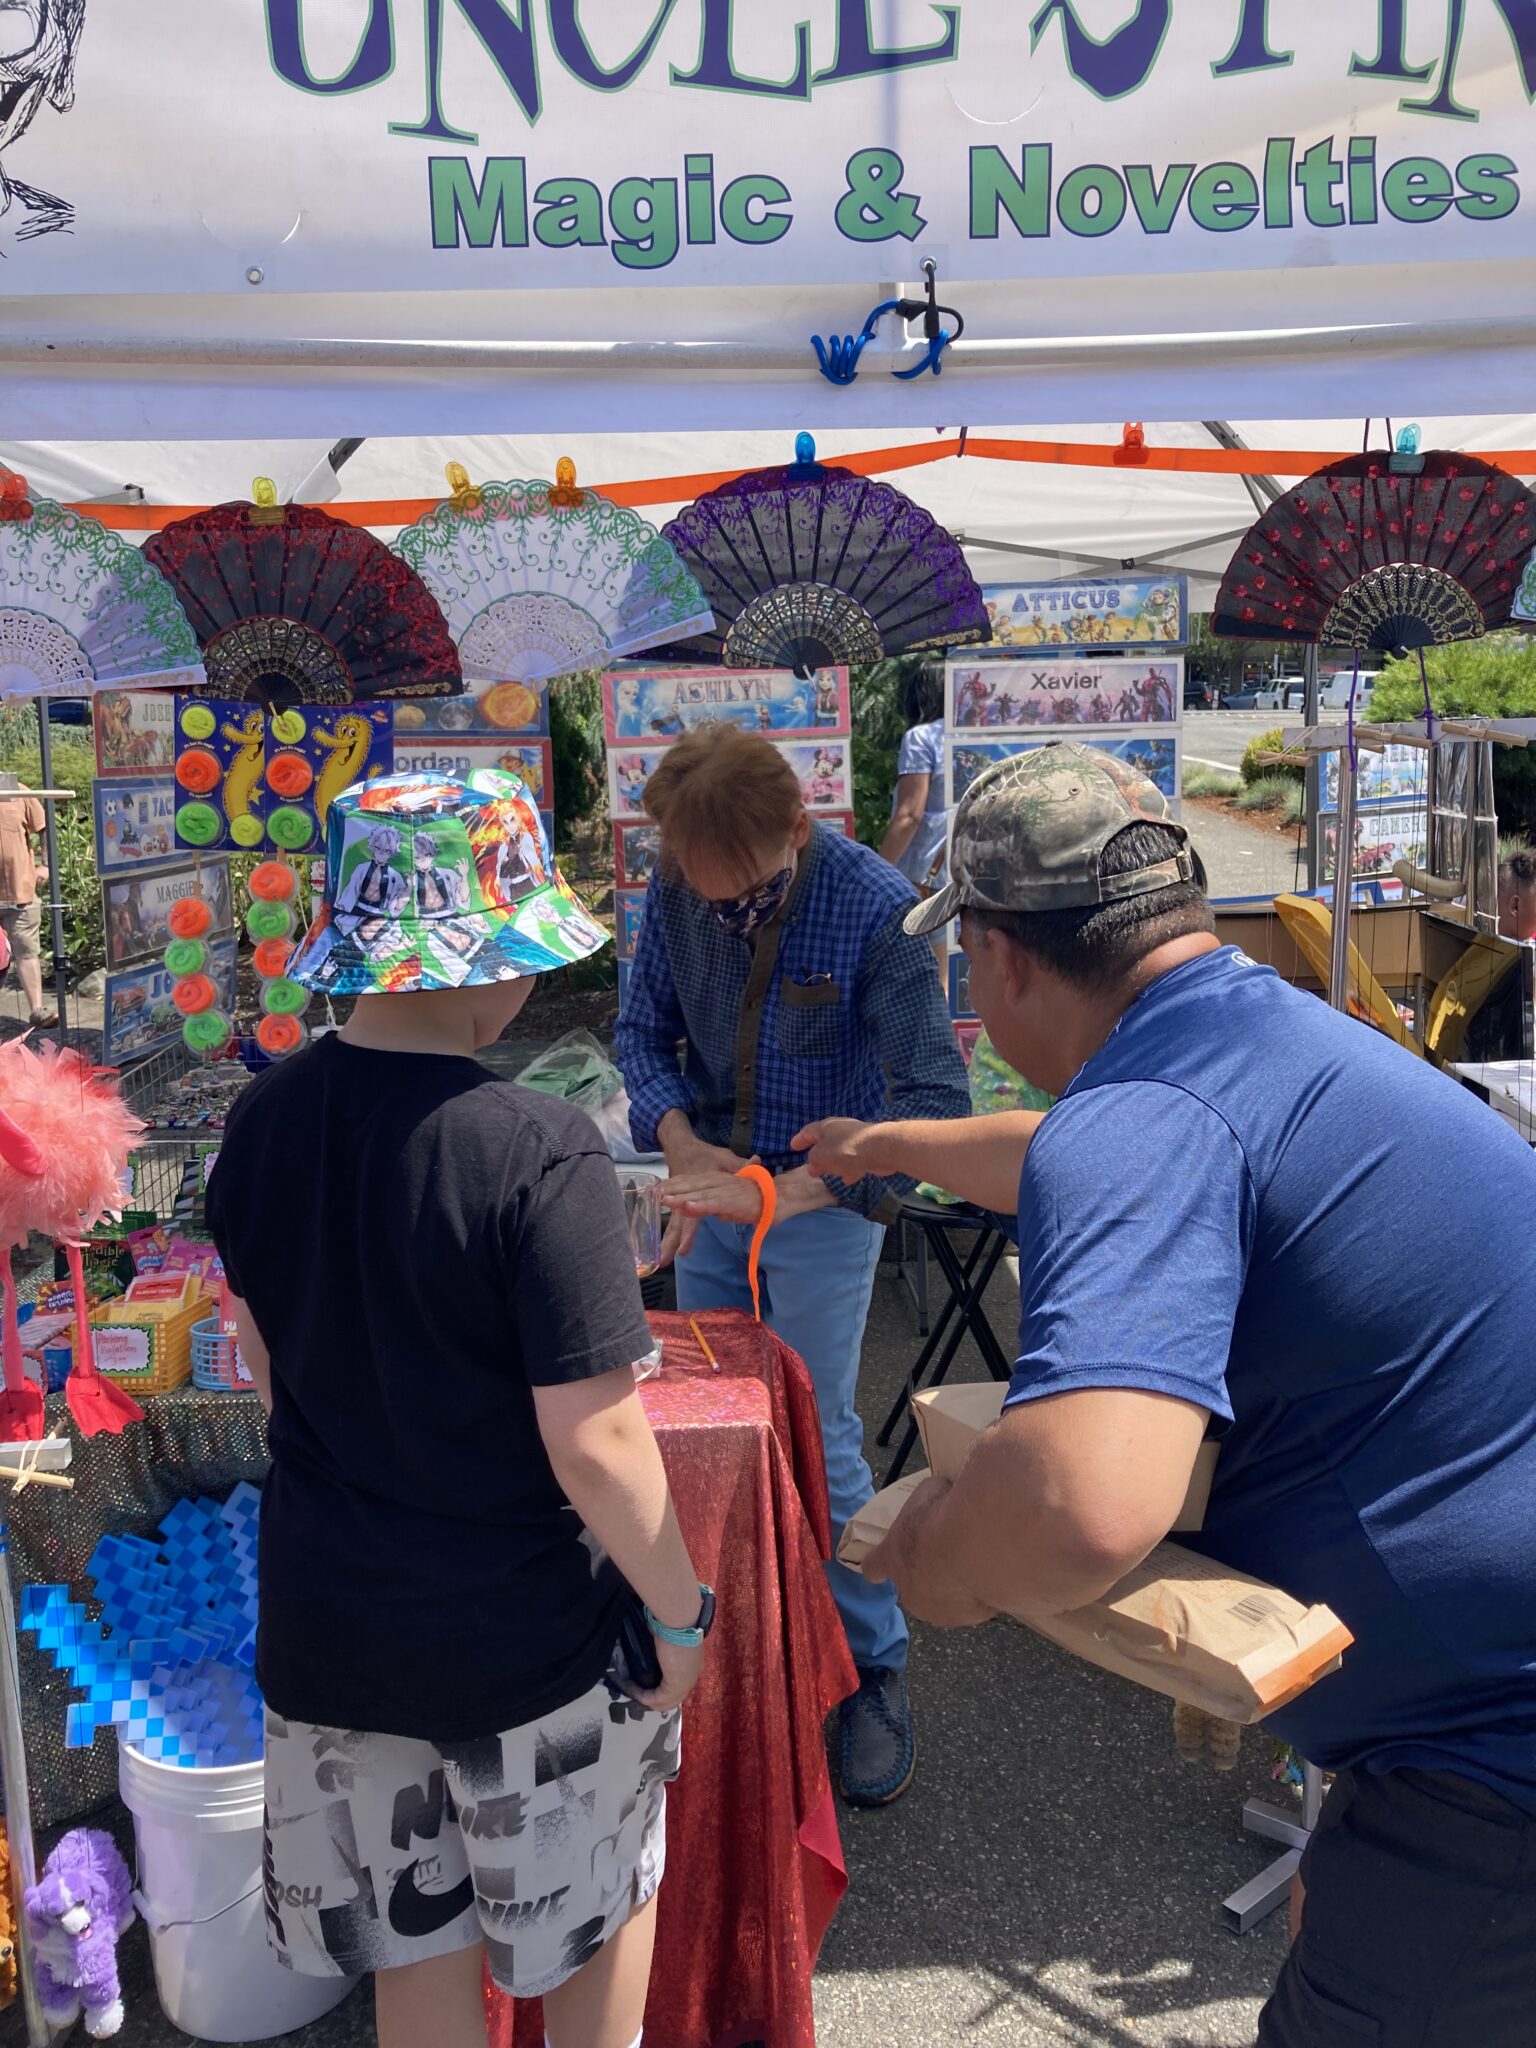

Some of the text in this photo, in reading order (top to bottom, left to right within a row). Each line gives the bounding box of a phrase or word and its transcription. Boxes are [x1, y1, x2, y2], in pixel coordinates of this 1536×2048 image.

[428, 135, 1520, 269] Magic & Novelties
[1012, 589, 1121, 613] ATTICUS
[672, 677, 772, 705] ASHLYN
[1030, 672, 1102, 691] Xavier
